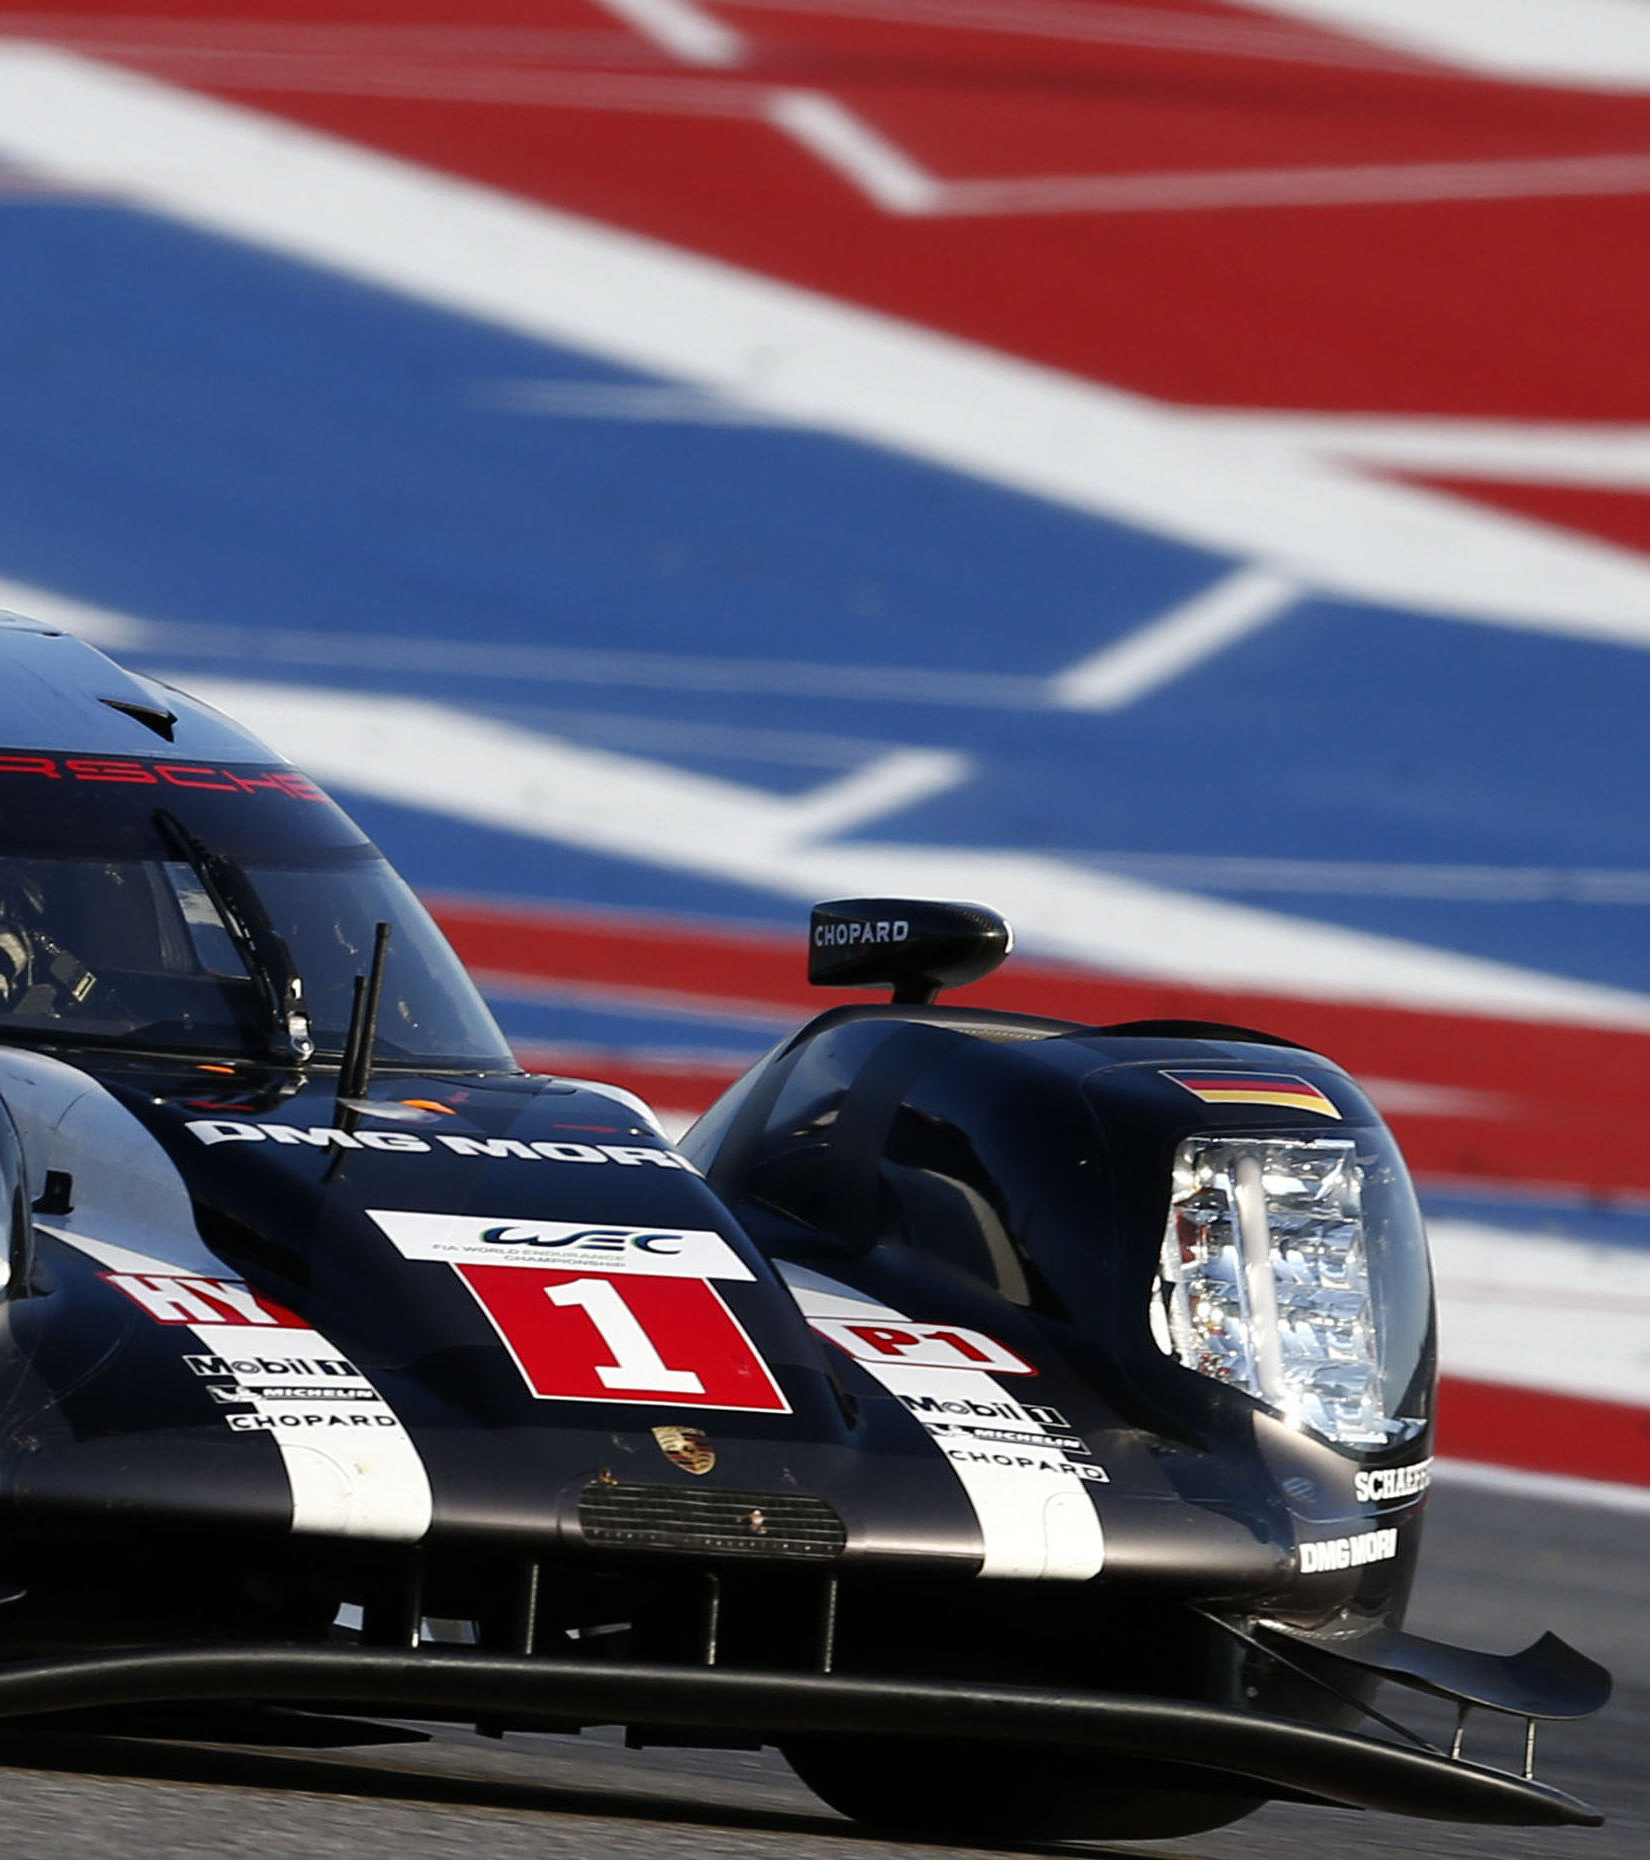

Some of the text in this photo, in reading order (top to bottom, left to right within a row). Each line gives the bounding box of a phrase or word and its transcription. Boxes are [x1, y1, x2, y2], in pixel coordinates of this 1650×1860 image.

[814, 920, 910, 947] CHOPARD
[184, 1119, 707, 1180] DMG MORI
[462, 1245, 520, 1256] WORLD
[479, 1225, 684, 1255] WEC
[105, 1274, 281, 1325] HY
[543, 1278, 707, 1395] 1
[841, 1324, 996, 1364] P1
[186, 1354, 315, 1376] Mobil
[262, 1387, 374, 1399] MICHELIN
[231, 1414, 398, 1429] CHOPARD
[897, 1395, 1024, 1421] Mobil
[973, 1428, 1082, 1449] MICHELIN
[949, 1450, 1104, 1479] CHOPARD
[1298, 1527, 1399, 1574] DMG MORI
